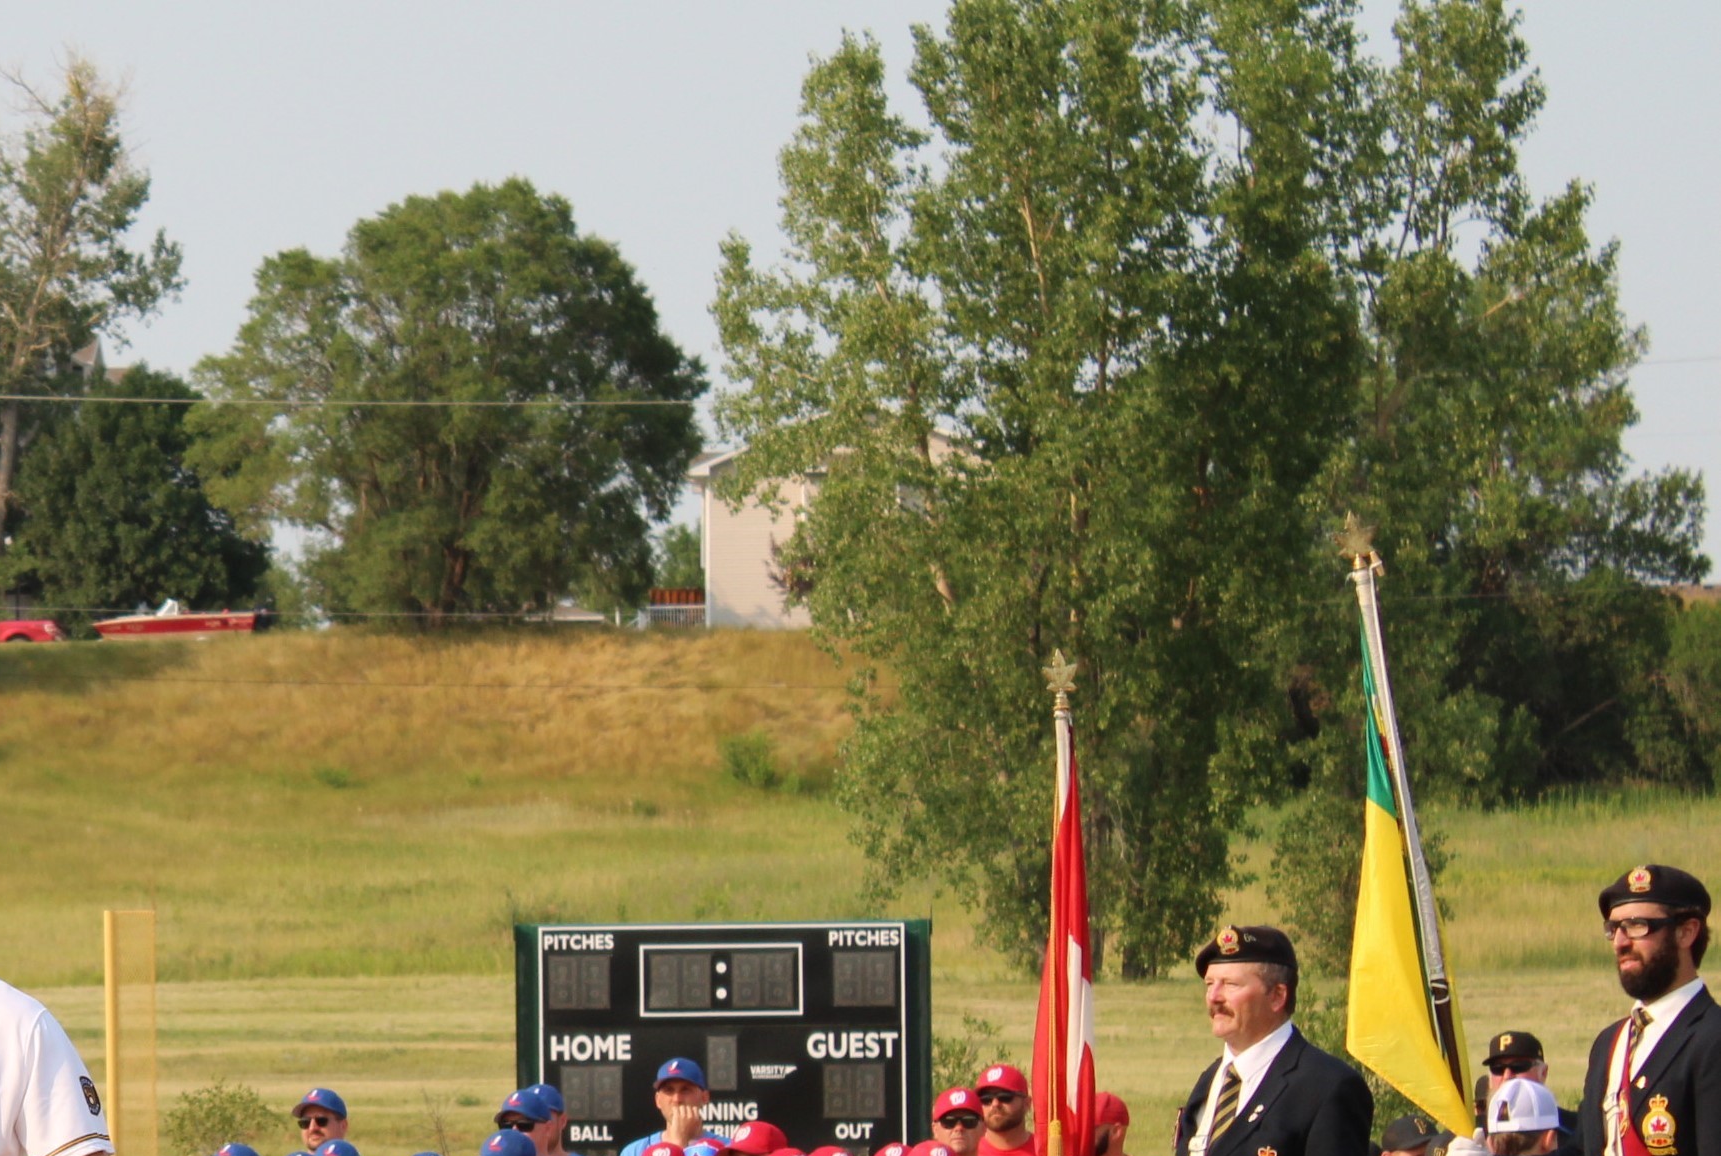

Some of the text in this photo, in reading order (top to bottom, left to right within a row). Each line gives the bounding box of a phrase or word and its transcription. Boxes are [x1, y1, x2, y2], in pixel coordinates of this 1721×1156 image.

[543, 934, 615, 951] PITCHES
[828, 930, 900, 947] PITCHES
[550, 1034, 632, 1061] HOME
[806, 1031, 899, 1059] GUEST
[1499, 1034, 1514, 1052] P
[698, 1102, 759, 1121] NNING
[570, 1125, 613, 1142] BALL
[835, 1123, 874, 1140] OUT
